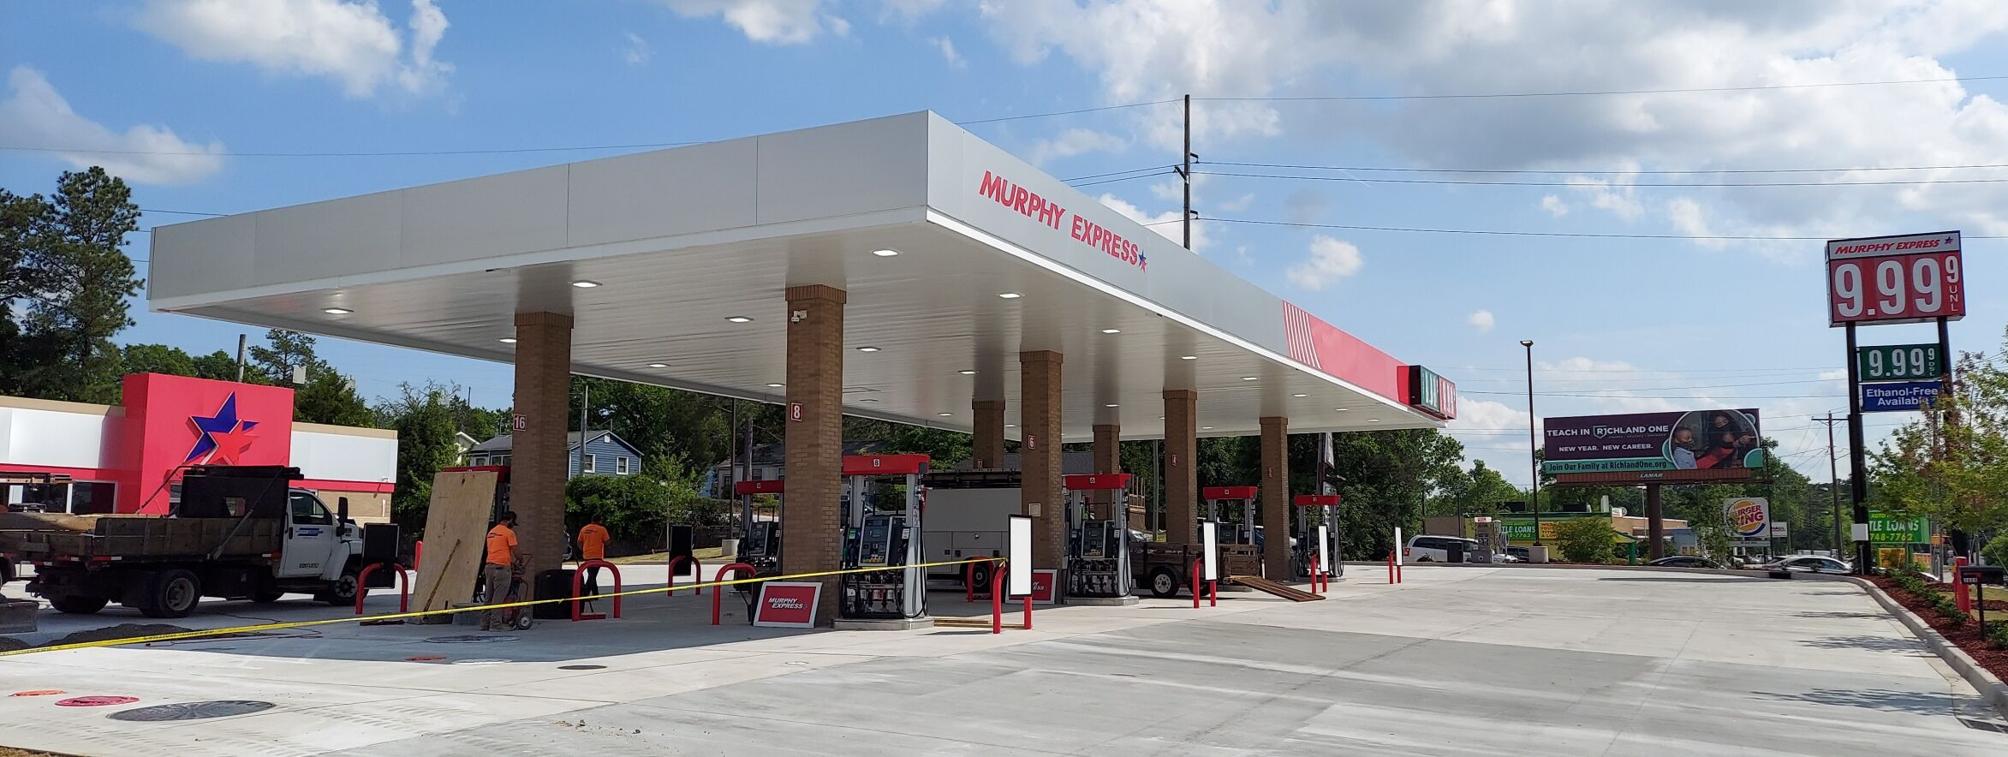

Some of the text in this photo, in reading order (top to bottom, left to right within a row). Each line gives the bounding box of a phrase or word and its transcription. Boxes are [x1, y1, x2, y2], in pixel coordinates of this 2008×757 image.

[979, 170, 1139, 265] MURPHY EXPRESS
[1835, 239, 1940, 254] MURPHY EXPRESS
[1835, 255, 1959, 317] 9.99 9
[1949, 285, 1959, 312] UNL
[1868, 348, 1935, 377] 9.99 9
[1866, 387, 1938, 398] Ethanol-Free
[794, 405, 801, 419] 8
[515, 416, 526, 429] 16
[1546, 429, 1578, 437] TEACH
[1648, 425, 1669, 433] ONE
[1578, 463, 1600, 471] Family
[1736, 504, 1761, 517] URGER
[1887, 520, 1919, 531] LOANS
